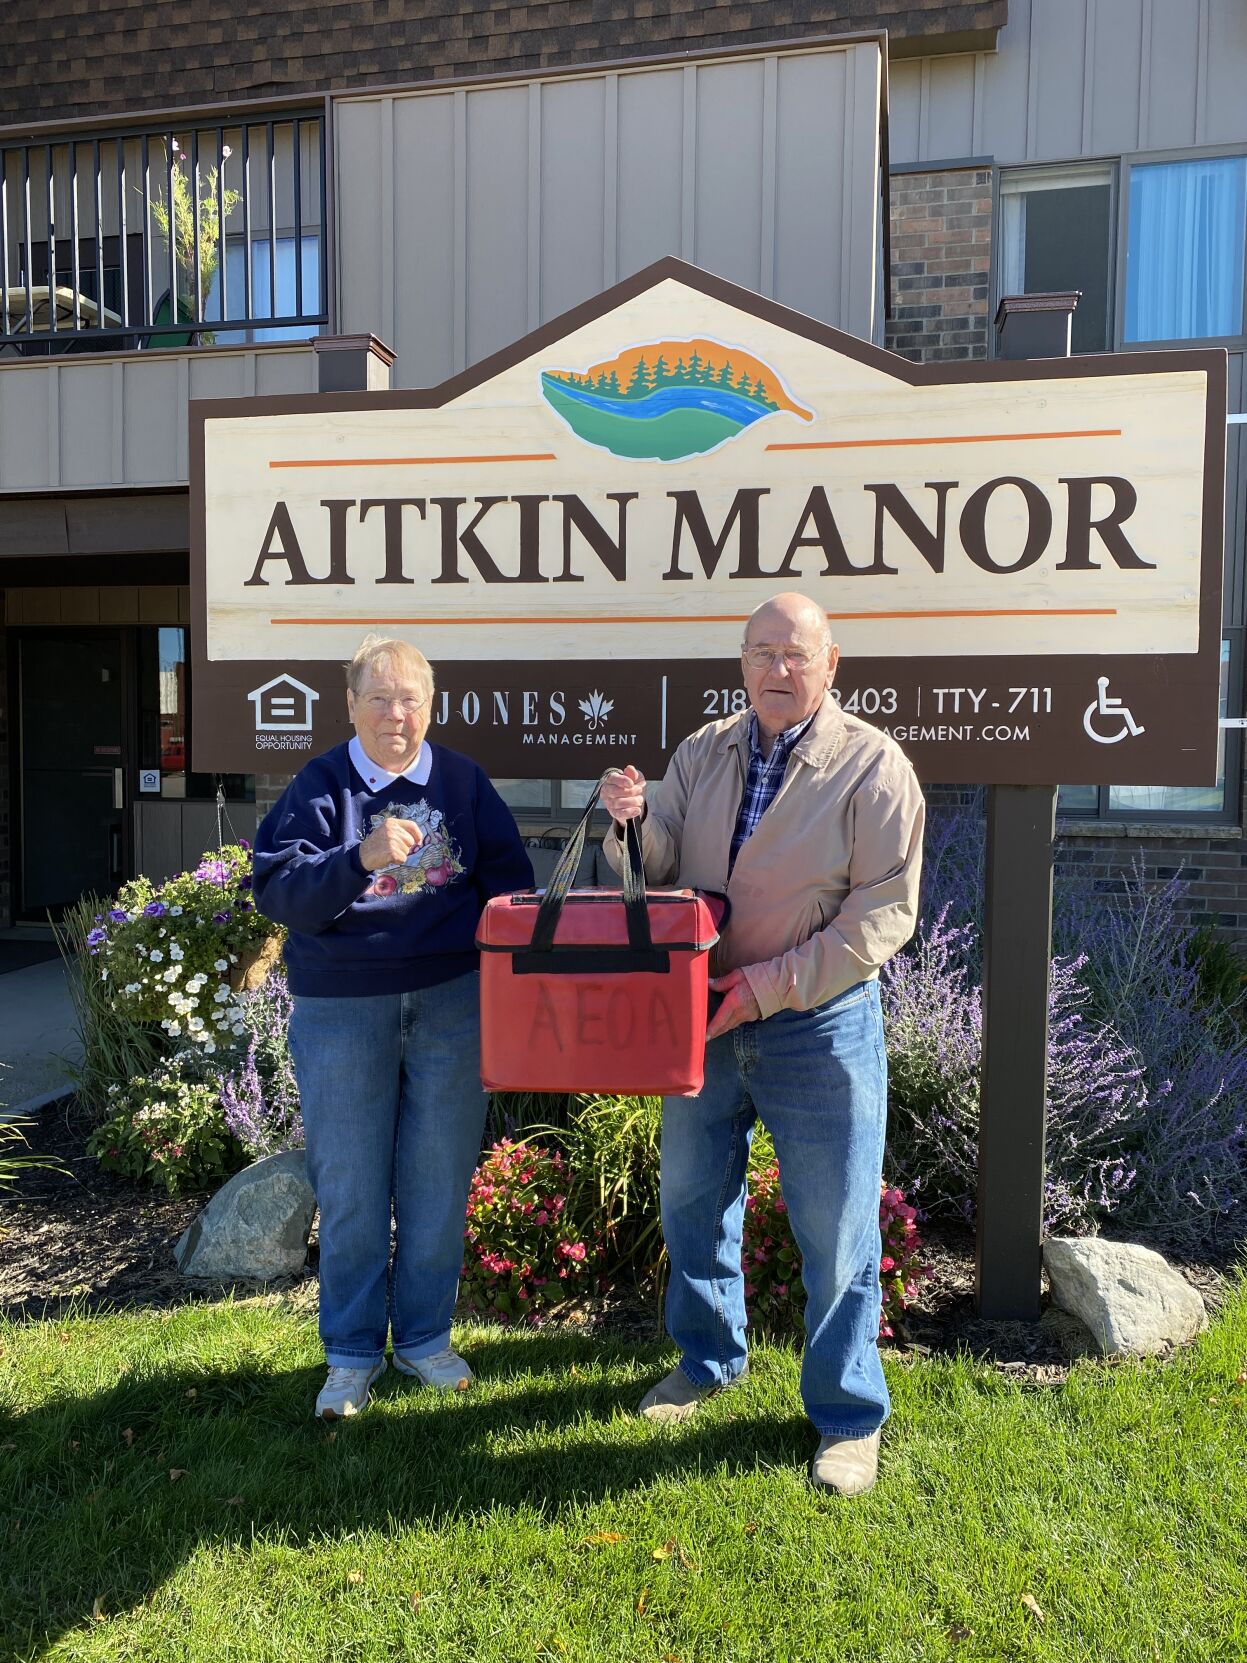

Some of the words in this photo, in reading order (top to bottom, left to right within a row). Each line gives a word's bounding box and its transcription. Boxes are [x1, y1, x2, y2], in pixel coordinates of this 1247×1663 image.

[244, 492, 638, 586] AITKIN
[662, 476, 1157, 580] MANOR
[436, 690, 566, 726] JONES
[702, 688, 747, 714] 218
[255, 742, 312, 750] OPPORTUNITY
[522, 733, 637, 745] MANAGEMENT
[527, 980, 679, 1052] AEOA
